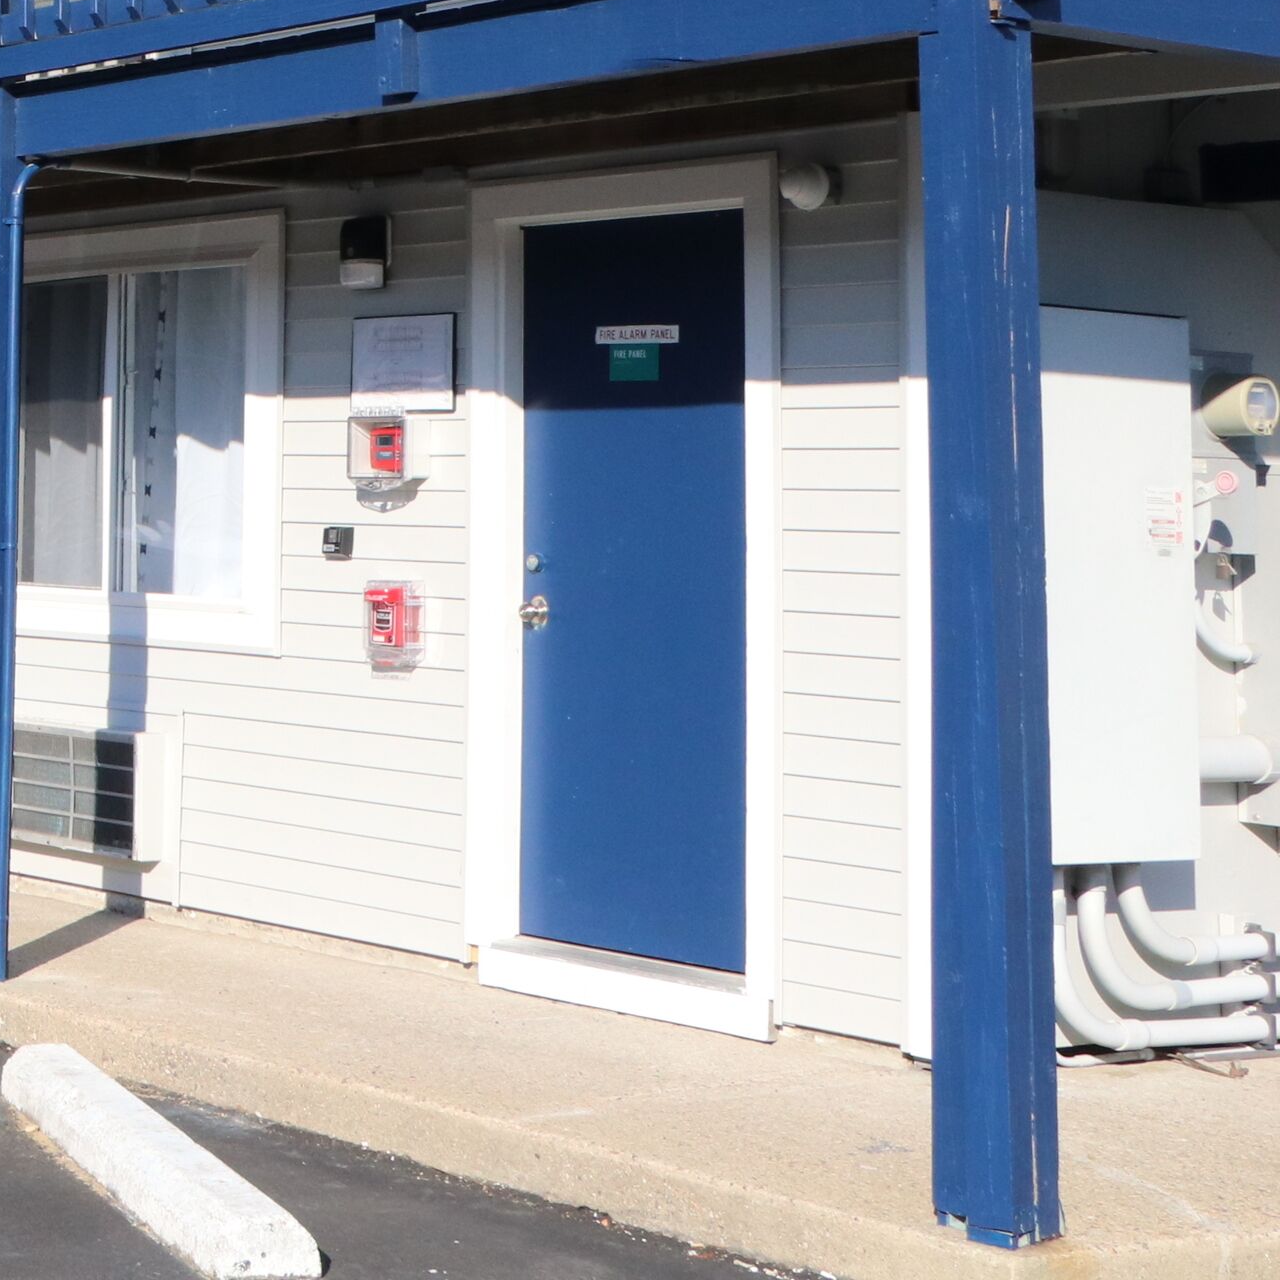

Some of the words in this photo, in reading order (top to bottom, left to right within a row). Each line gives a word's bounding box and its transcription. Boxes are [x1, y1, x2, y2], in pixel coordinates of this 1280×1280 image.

[600, 330, 615, 341] FIRE
[619, 329, 647, 340] ALARM
[651, 328, 676, 340] PANEL
[614, 350, 627, 360] FIRE
[628, 349, 647, 359] PANEL
